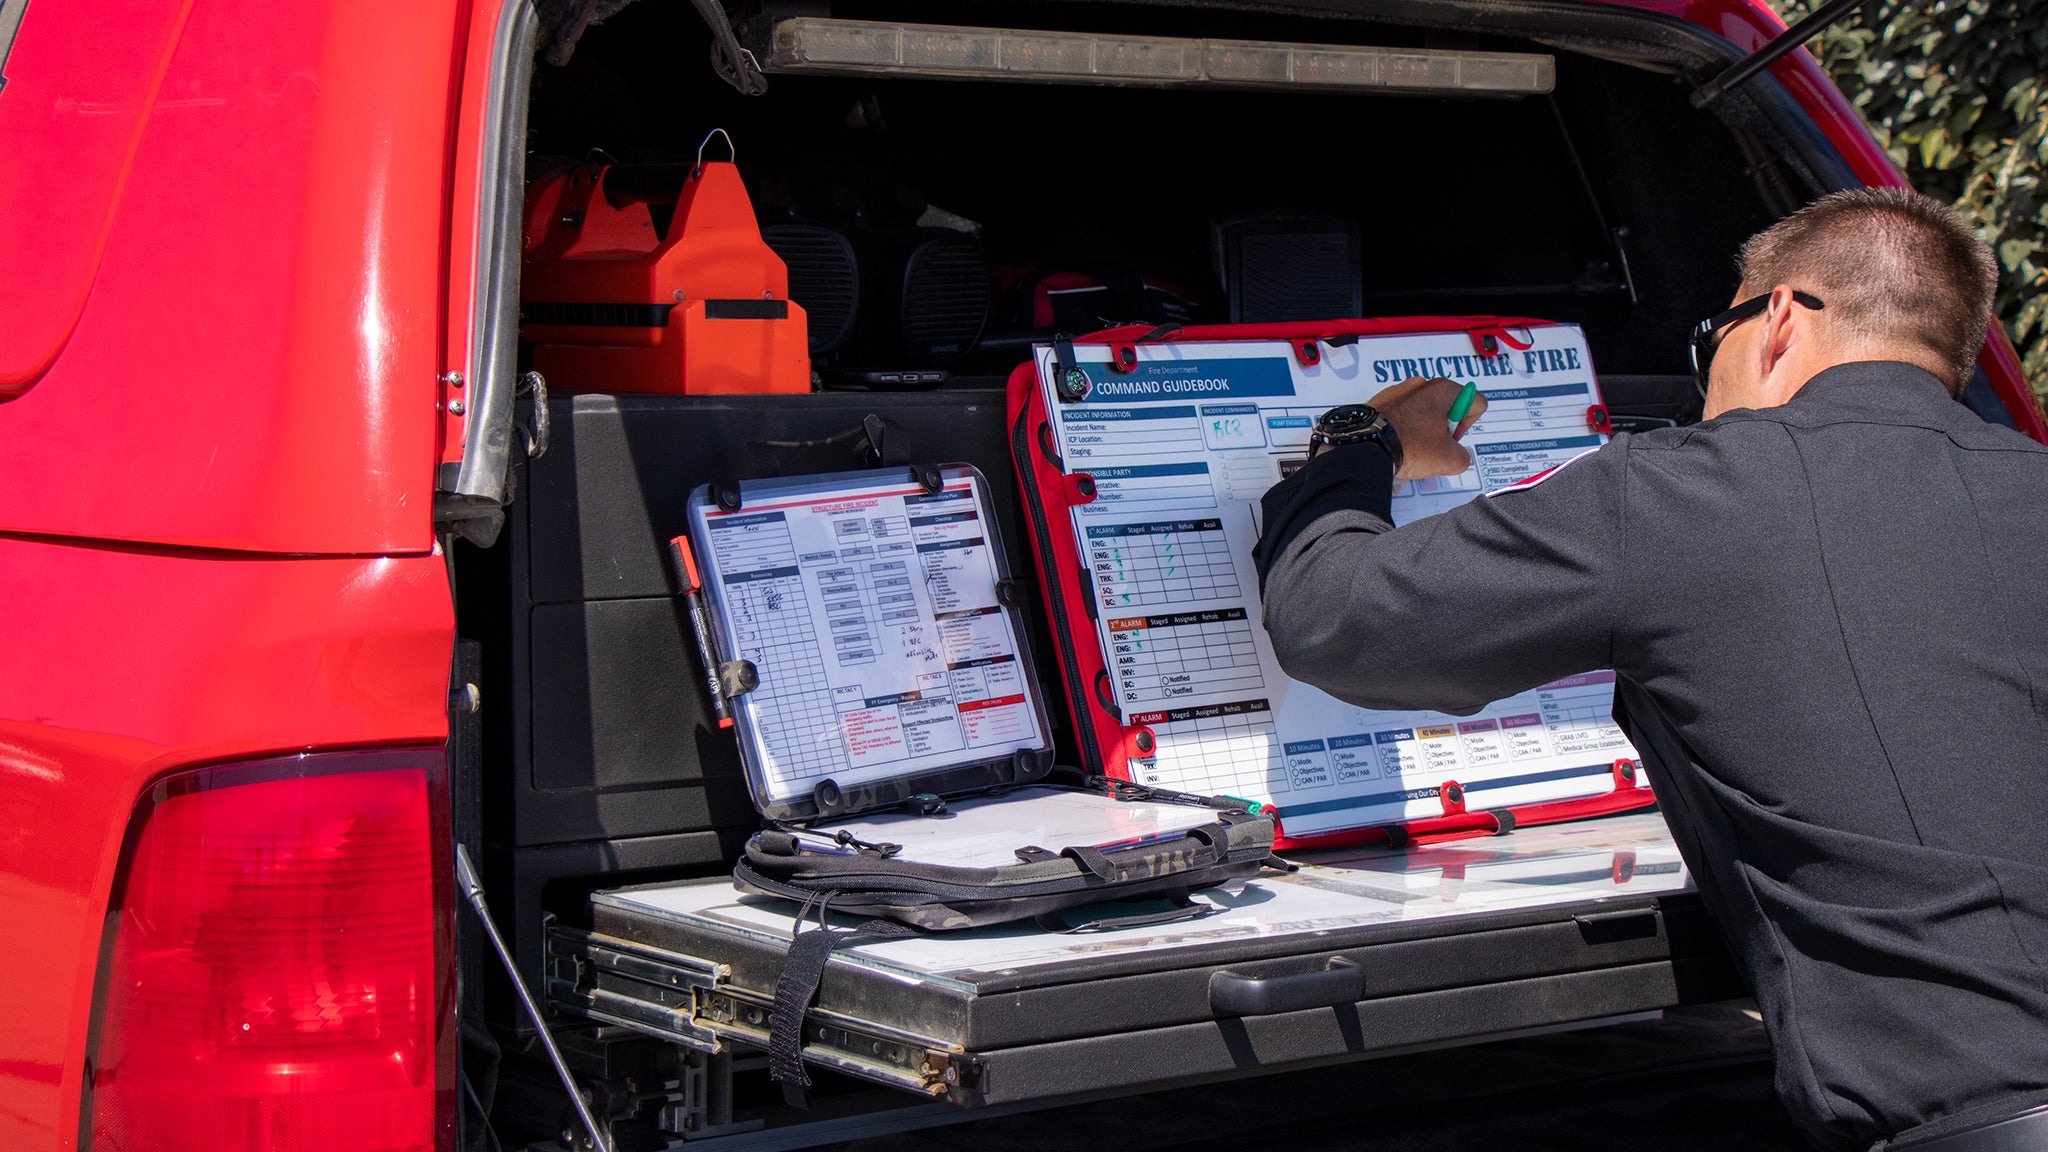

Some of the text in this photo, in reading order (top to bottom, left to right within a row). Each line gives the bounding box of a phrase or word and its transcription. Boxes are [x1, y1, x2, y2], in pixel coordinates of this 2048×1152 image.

[1373, 348, 1581, 382] STRUCTURE FIRE
[1149, 366, 1198, 375] Fire Department
[1097, 378, 1230, 395] COMMAND GUIDEBOOK
[1078, 435, 1103, 443] Location:
[1512, 441, 1557, 450] CONSIDERATIONS
[1070, 448, 1092, 456] Staging:
[1075, 469, 1111, 477] ONSIBLE
[1499, 465, 1528, 473] Completed
[1127, 526, 1145, 534] Staged
[1151, 524, 1173, 533] Assigned
[1120, 620, 1142, 628] ALARM
[1150, 618, 1168, 626] Staged
[1174, 616, 1196, 624] Assigned
[1119, 657, 1136, 665] AMR:
[1169, 675, 1190, 683] Notified
[1141, 714, 1162, 722] ALARM
[1172, 711, 1189, 719] Staged
[1196, 708, 1219, 716] Assigned
[1298, 743, 1320, 751] Minutes
[1563, 743, 1583, 752] Medical
[1343, 761, 1368, 769] Objectives
[1300, 767, 1325, 775] Objectives
